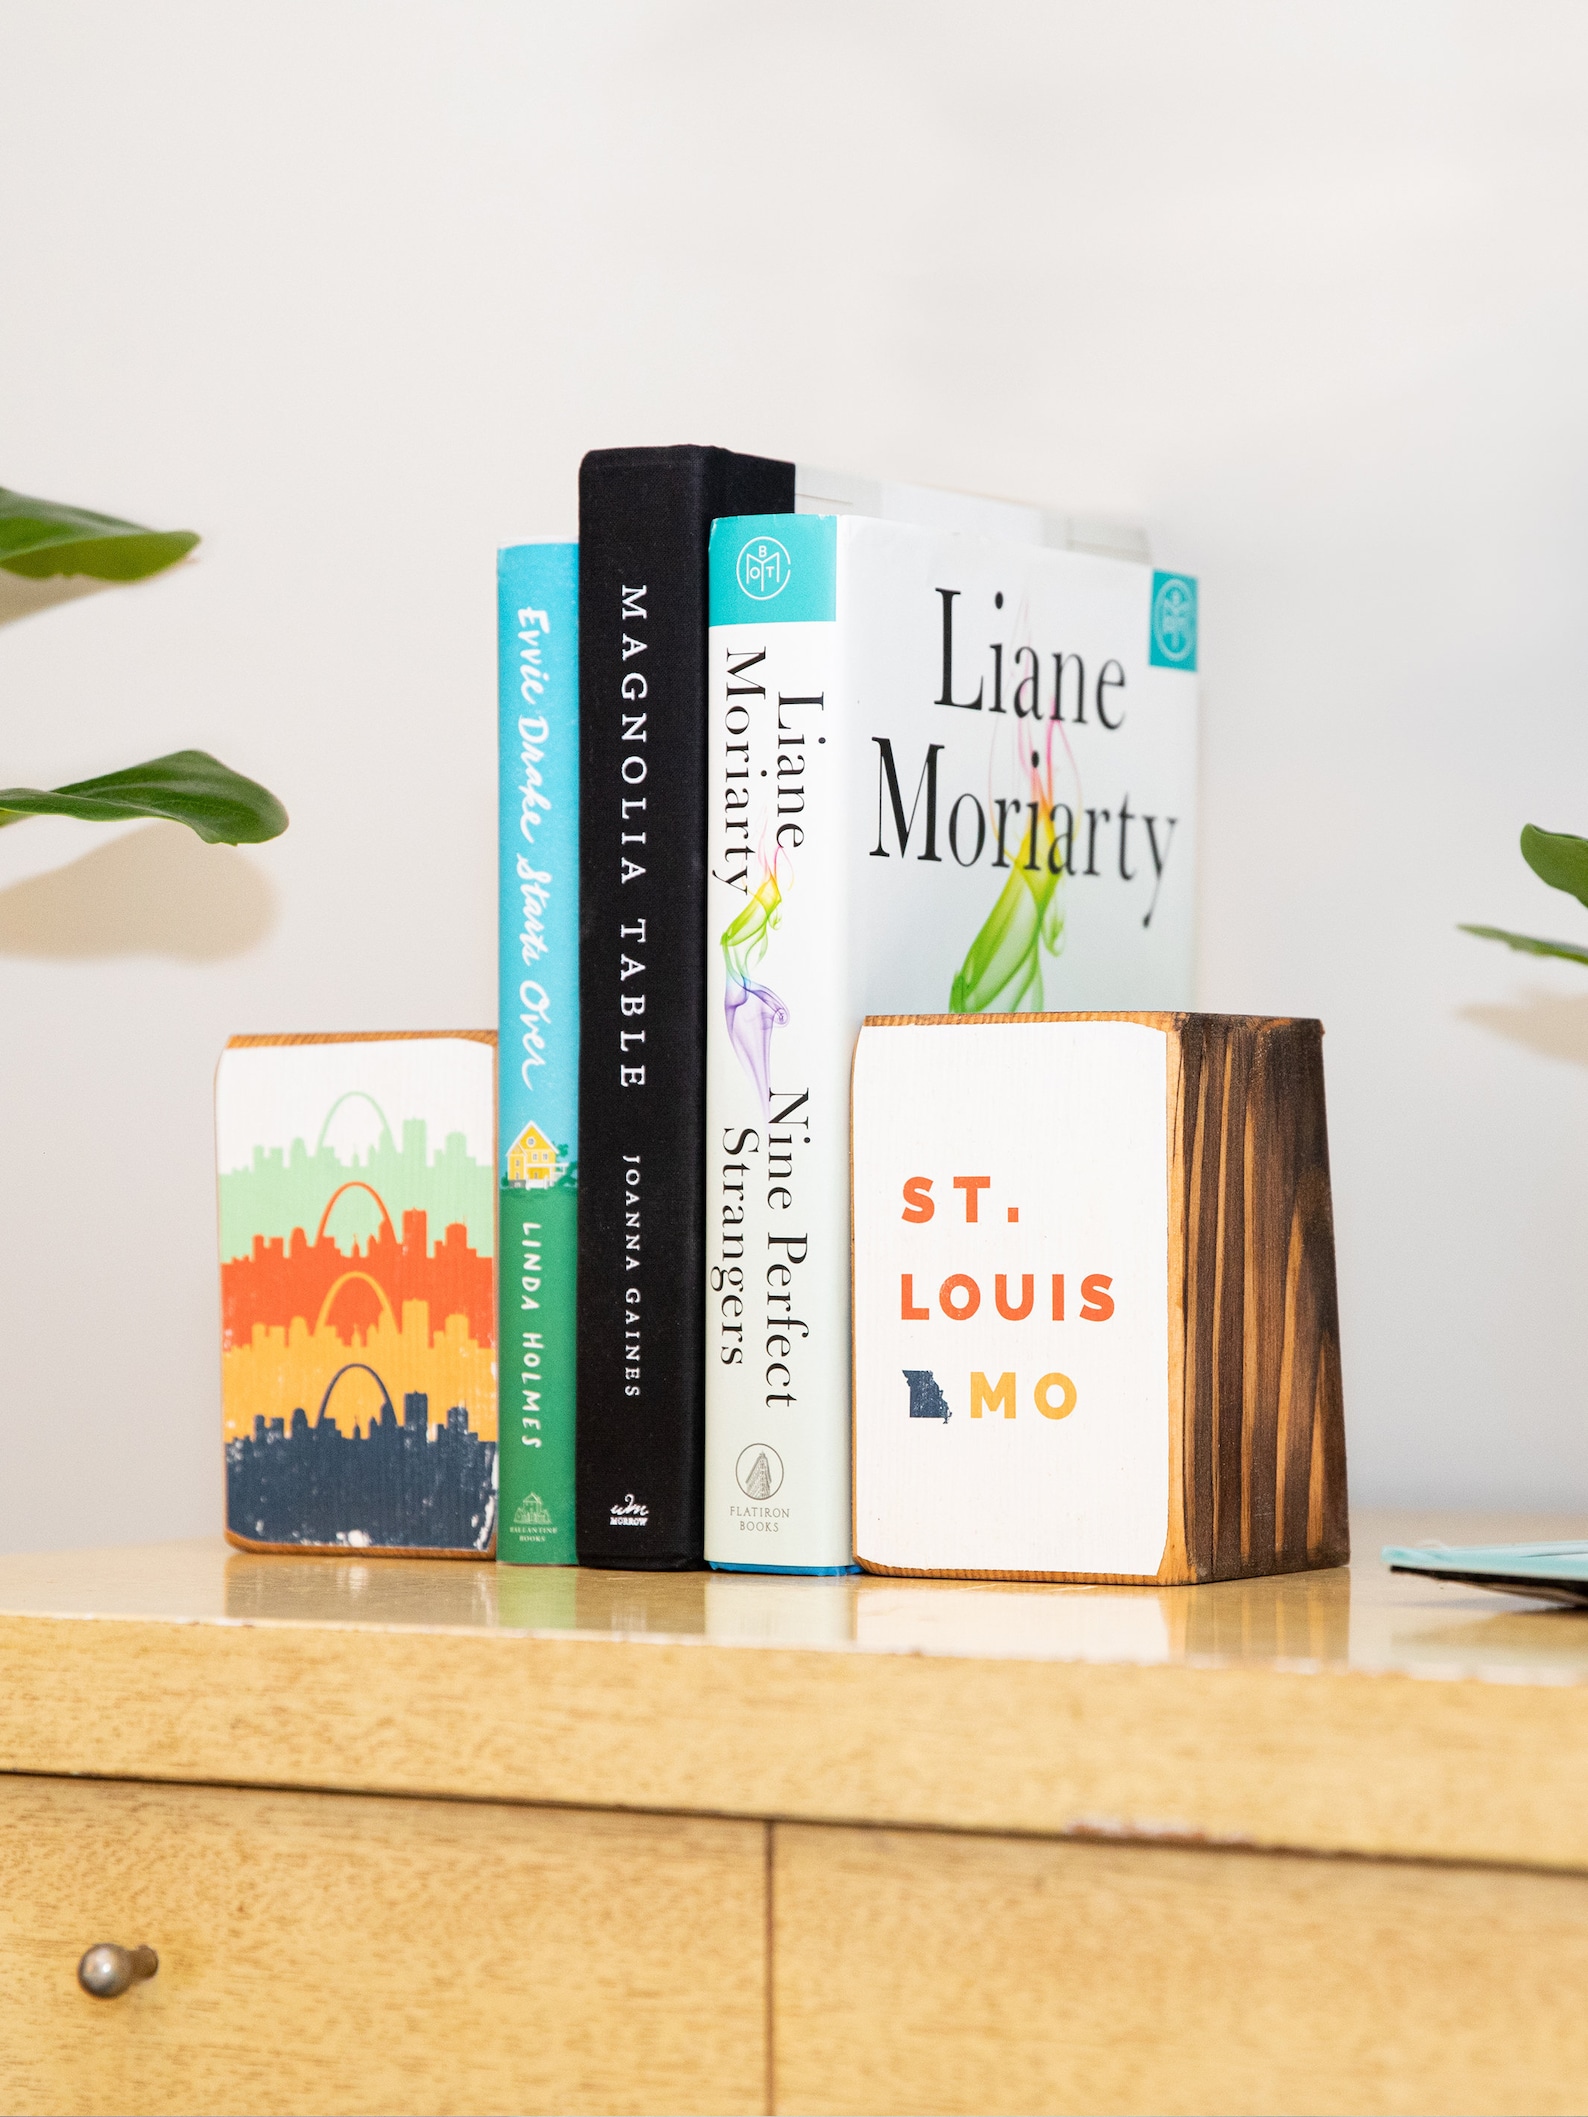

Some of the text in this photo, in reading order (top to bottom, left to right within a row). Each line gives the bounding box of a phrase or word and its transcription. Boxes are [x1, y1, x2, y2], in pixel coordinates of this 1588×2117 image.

[934, 587, 1126, 731] Liane
[516, 606, 554, 1091] Evvie Drake Starts Over
[620, 584, 648, 1088] MAGNOLIA TABLE
[713, 646, 768, 896] Moriarty
[776, 690, 827, 849] Liane
[869, 735, 1179, 929] Moriarty
[622, 1155, 641, 1397] JOANNA GAINES
[710, 1127, 760, 1366] Strangers
[765, 1087, 812, 1408] Nine Perfect
[901, 1175, 1019, 1224] ST.
[520, 1221, 545, 1449] LINDA HOLMES
[901, 1273, 1115, 1322] LOUIS
[970, 1371, 1078, 1420] MO
[729, 1506, 790, 1518] FLATIRON
[739, 1520, 779, 1533] BOOKS
